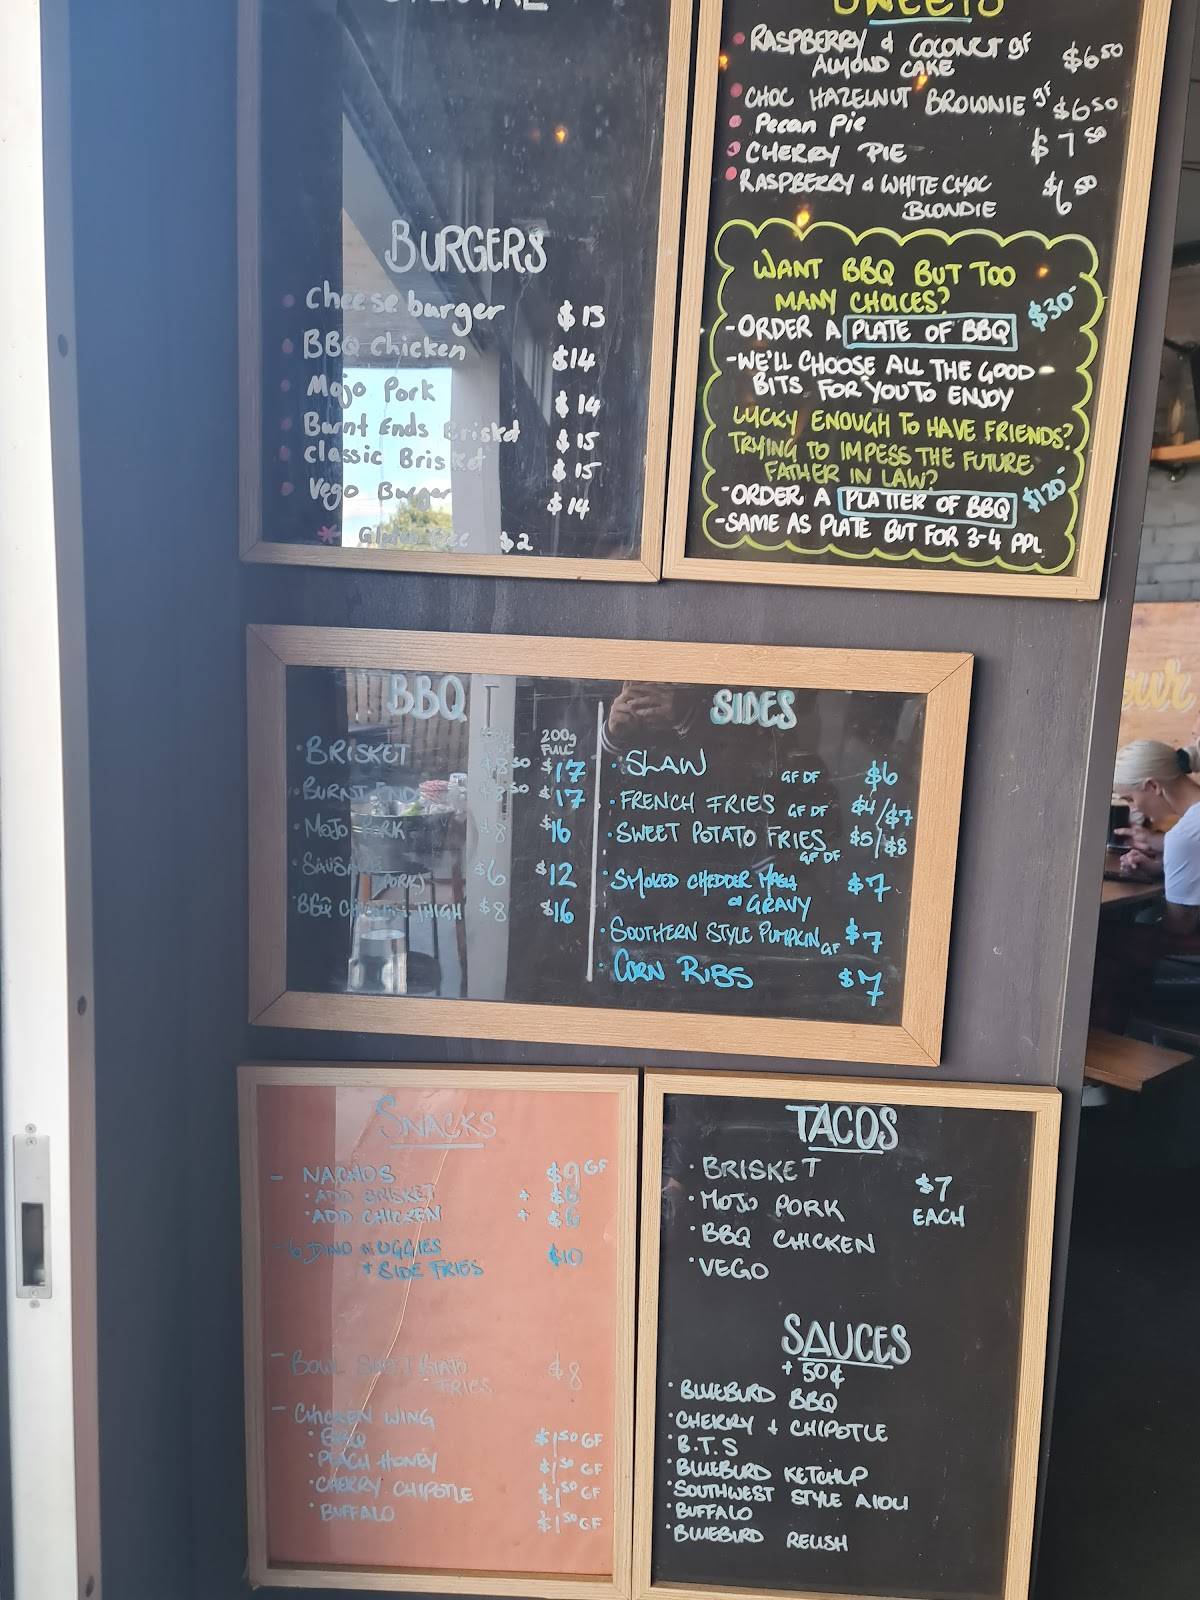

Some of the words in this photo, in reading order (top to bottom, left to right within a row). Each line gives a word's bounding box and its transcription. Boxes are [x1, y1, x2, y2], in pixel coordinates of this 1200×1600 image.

[750, 23, 868, 58] RASPBERRY
[900, 58, 955, 79] CAKE
[744, 86, 795, 110] CHOC
[809, 86, 912, 110] HAZELNUT
[925, 90, 1026, 116] BROWNIE
[755, 113, 817, 135] Pecan
[829, 107, 867, 137] Pie
[745, 143, 840, 167] CHERRY
[857, 142, 907, 163] PIE
[740, 168, 854, 196] RASPBERRY
[881, 174, 936, 196] WHITE
[942, 174, 993, 195] CHOC
[902, 200, 997, 221] BLONDIE
[385, 220, 548, 274] BURGERS
[753, 249, 823, 281] WANT
[842, 255, 896, 287] BBQ
[914, 263, 963, 288] BUT
[969, 262, 1017, 288] TOO
[775, 289, 836, 315] MANY
[850, 286, 951, 317] CHOICES?
[304, 329, 360, 359] BBQ
[825, 319, 842, 340] A
[851, 320, 912, 343] PLATE
[925, 320, 951, 342] OF
[962, 319, 1011, 348] BBQ
[799, 350, 876, 378] CHOOSE
[886, 355, 925, 377] ALL
[929, 358, 972, 381] THE
[978, 361, 1035, 383] GOOD
[307, 374, 366, 409] Mojo
[384, 376, 436, 402] Pork
[752, 372, 804, 397] BITS
[819, 375, 864, 400] FOR
[948, 385, 1014, 412] ENJOY
[304, 411, 368, 437] Burnt
[379, 412, 430, 437] Ends
[733, 405, 799, 436] LUCKY
[811, 409, 891, 439] ENOUGH
[899, 412, 920, 436] TO
[926, 416, 977, 442] HAVE
[984, 419, 1075, 451] FRIENDS?
[728, 431, 799, 461] TRYING
[806, 440, 830, 461] TO
[916, 445, 956, 470] THE
[962, 450, 1035, 477] FUTURE
[764, 462, 841, 485] FATHER
[850, 468, 872, 486] IN
[881, 468, 939, 490] LAW?
[310, 478, 359, 511] Vego
[815, 487, 832, 507] A
[845, 488, 926, 511] PLATTER
[935, 494, 960, 514] OF
[966, 496, 1011, 522] BBQ
[786, 512, 812, 535] AS
[820, 512, 872, 540] PLATE
[884, 519, 916, 544] BUT
[925, 522, 958, 548] FOR
[967, 527, 1001, 551] 3-4
[1010, 531, 1044, 554] PPL
[386, 673, 467, 723] BBQ
[710, 688, 798, 730] SIDES
[306, 735, 411, 766] BRISKET
[625, 749, 707, 777] SLAW
[781, 770, 799, 784] GF
[803, 770, 821, 784] DF
[865, 760, 898, 791] $6
[620, 789, 696, 814] FRENCH
[706, 794, 776, 815] FRIES
[787, 804, 808, 818] GF
[810, 804, 829, 818] DF
[616, 822, 681, 844] SWEET
[692, 821, 757, 848] POTATO
[767, 826, 827, 852] FRIES
[800, 851, 820, 865] GF
[823, 850, 841, 862] DF
[610, 867, 679, 899] SMOKED
[687, 869, 752, 896] CHEDDER
[848, 871, 892, 903] $7
[746, 893, 812, 922] GRAVY
[610, 916, 699, 943] SOUTHERN
[706, 922, 754, 945] STYLE
[821, 942, 841, 956] GF
[845, 917, 883, 954] $7
[614, 947, 665, 982] CORN
[785, 1103, 899, 1151] TACOS
[702, 1156, 822, 1184] BRISKET
[915, 1173, 953, 1202] $7
[775, 1194, 845, 1222] PORK
[912, 1205, 966, 1228] EACH
[702, 1223, 751, 1249] BBQ
[772, 1229, 876, 1254] CHICKEN
[699, 1257, 770, 1280] VEGO
[781, 1313, 912, 1365] SAUCES
[789, 1388, 838, 1414] BBQ
[675, 1411, 755, 1436] CHERRY
[789, 1420, 889, 1442] CHIPOTLE
[784, 1465, 869, 1487] KETCHUP
[673, 1479, 775, 1502] SOUTHWEST
[790, 1489, 843, 1508] STYLE
[855, 1494, 909, 1511] AIOLI
[676, 1502, 753, 1521] BUFFALO
[786, 1531, 849, 1552] RELISH
